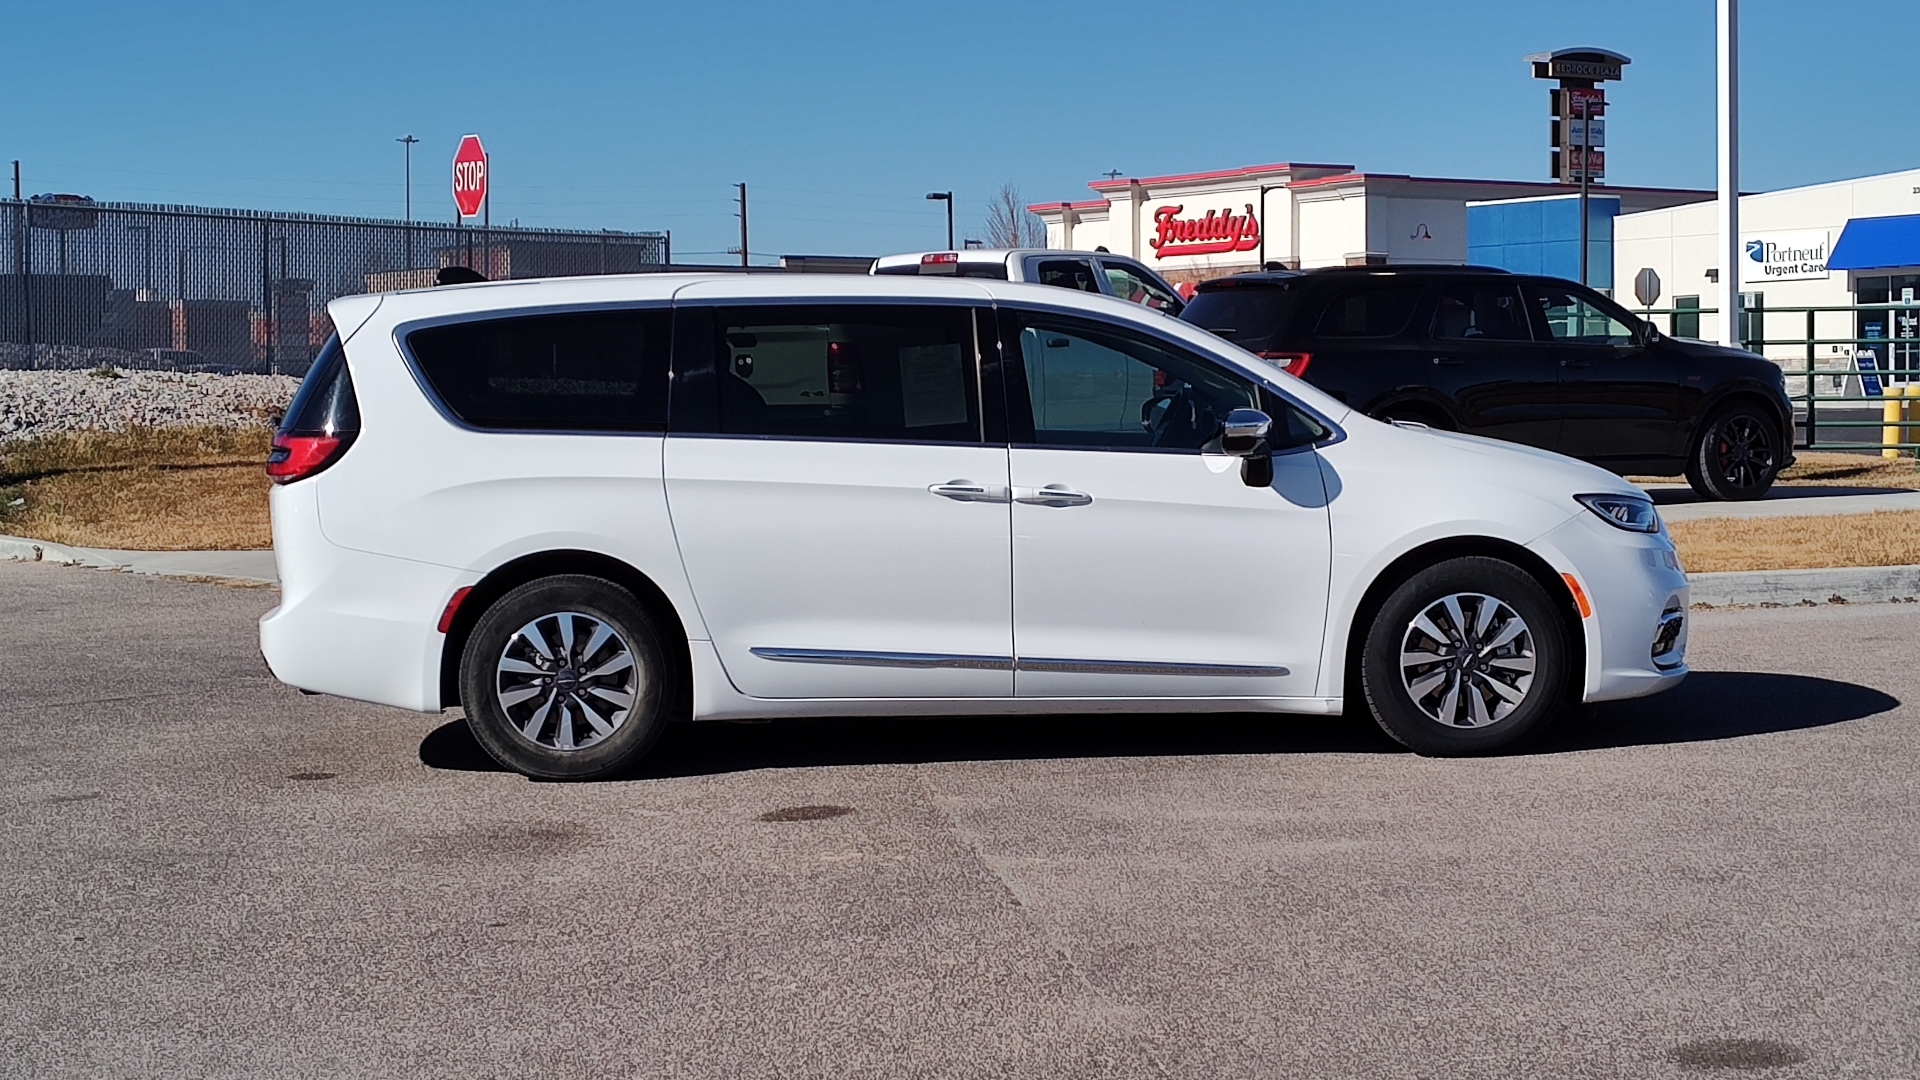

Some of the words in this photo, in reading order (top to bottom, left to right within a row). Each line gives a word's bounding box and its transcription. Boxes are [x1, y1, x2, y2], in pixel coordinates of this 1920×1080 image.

[455, 161, 484, 192] STOP
[1149, 203, 1260, 258] Freddy's
[1765, 241, 1825, 263] Portneuf
[1764, 264, 1799, 277] Urgent
[1801, 263, 1825, 273] Care
